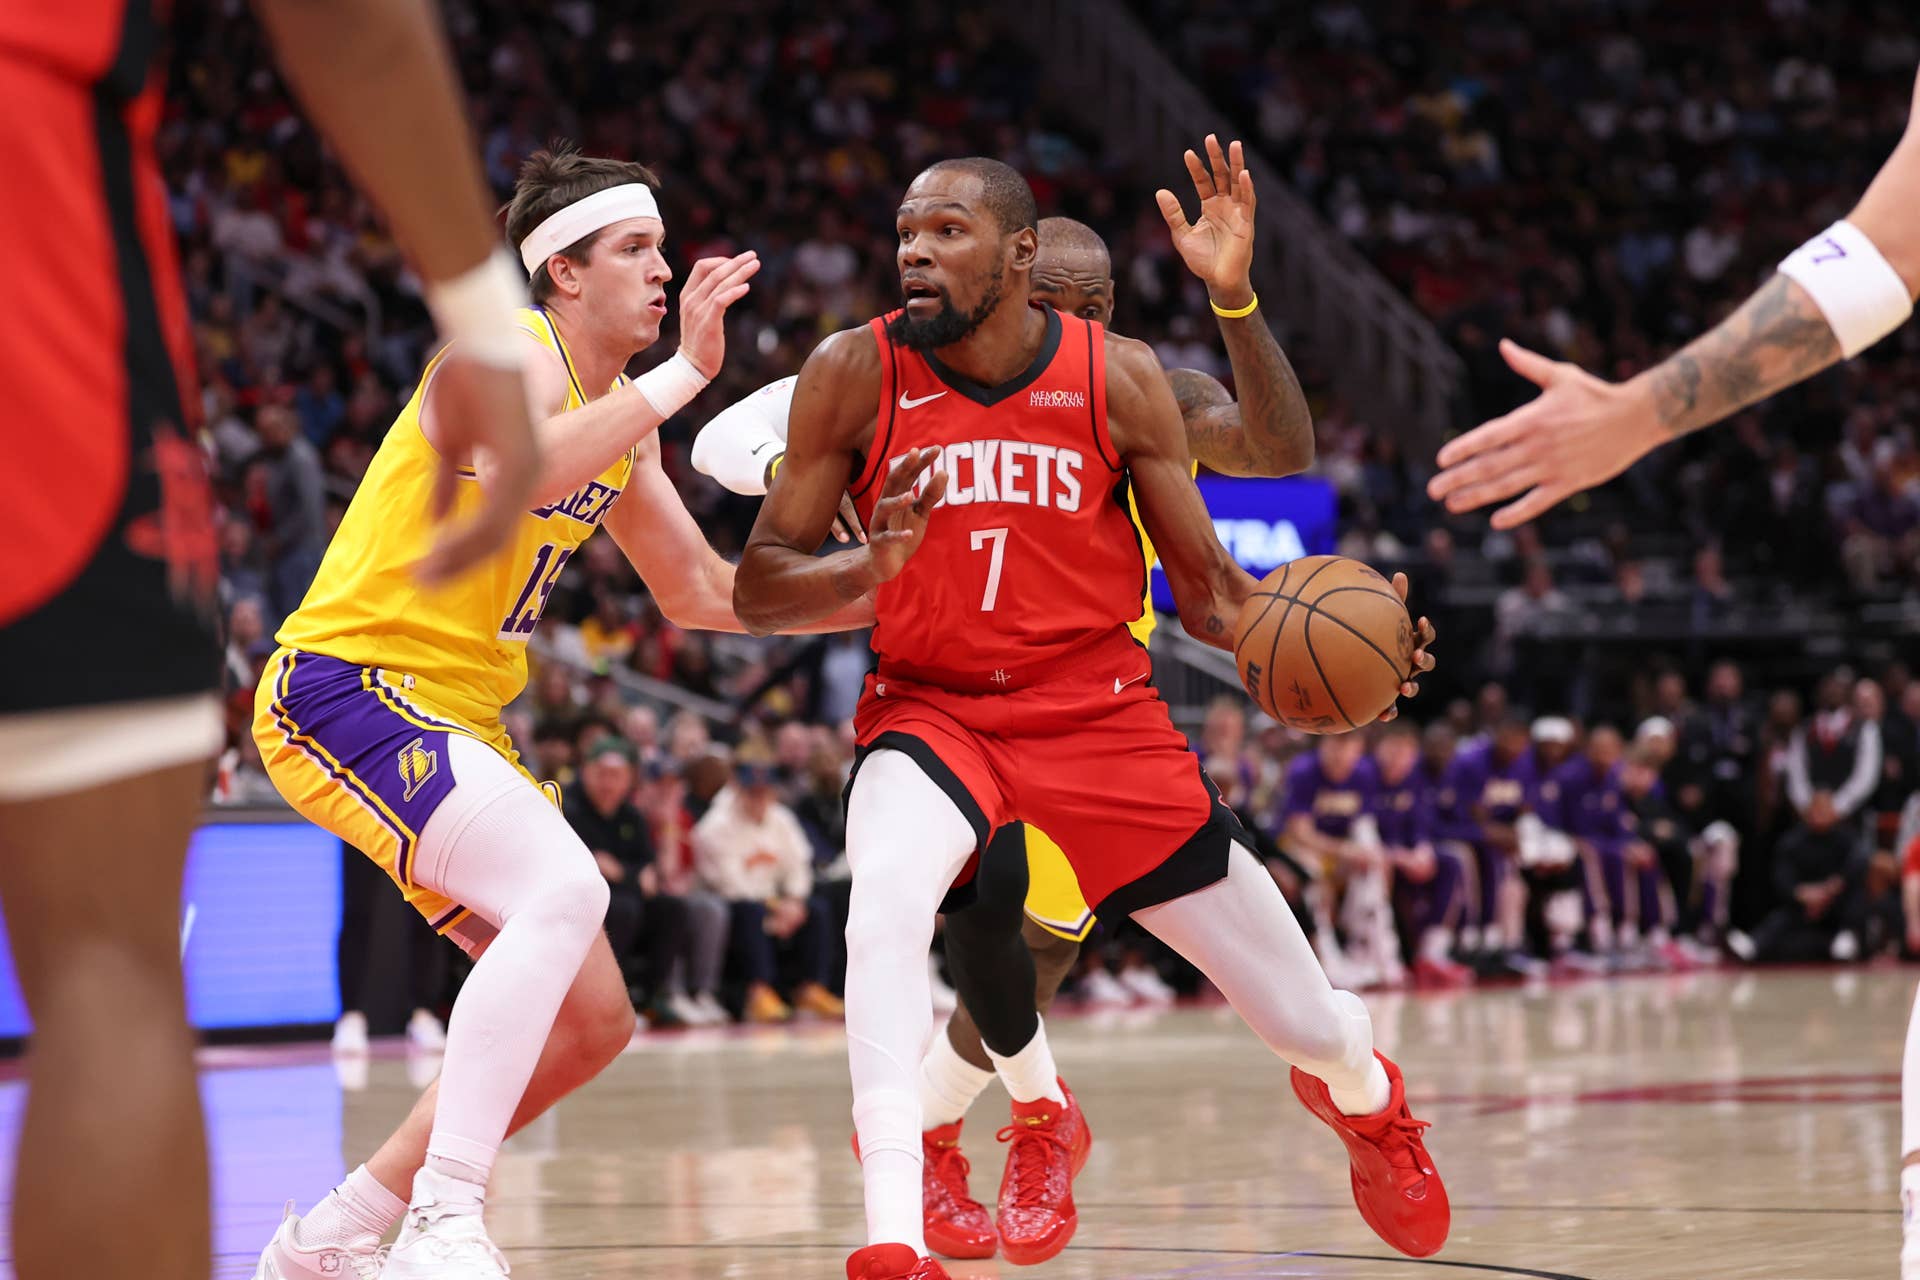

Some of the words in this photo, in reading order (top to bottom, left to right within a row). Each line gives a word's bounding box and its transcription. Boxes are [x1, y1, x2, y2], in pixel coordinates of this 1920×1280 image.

[1030, 390, 1083, 400] MEMORIAL
[1030, 399, 1084, 407] HERMANN
[970, 527, 1008, 612] 7
